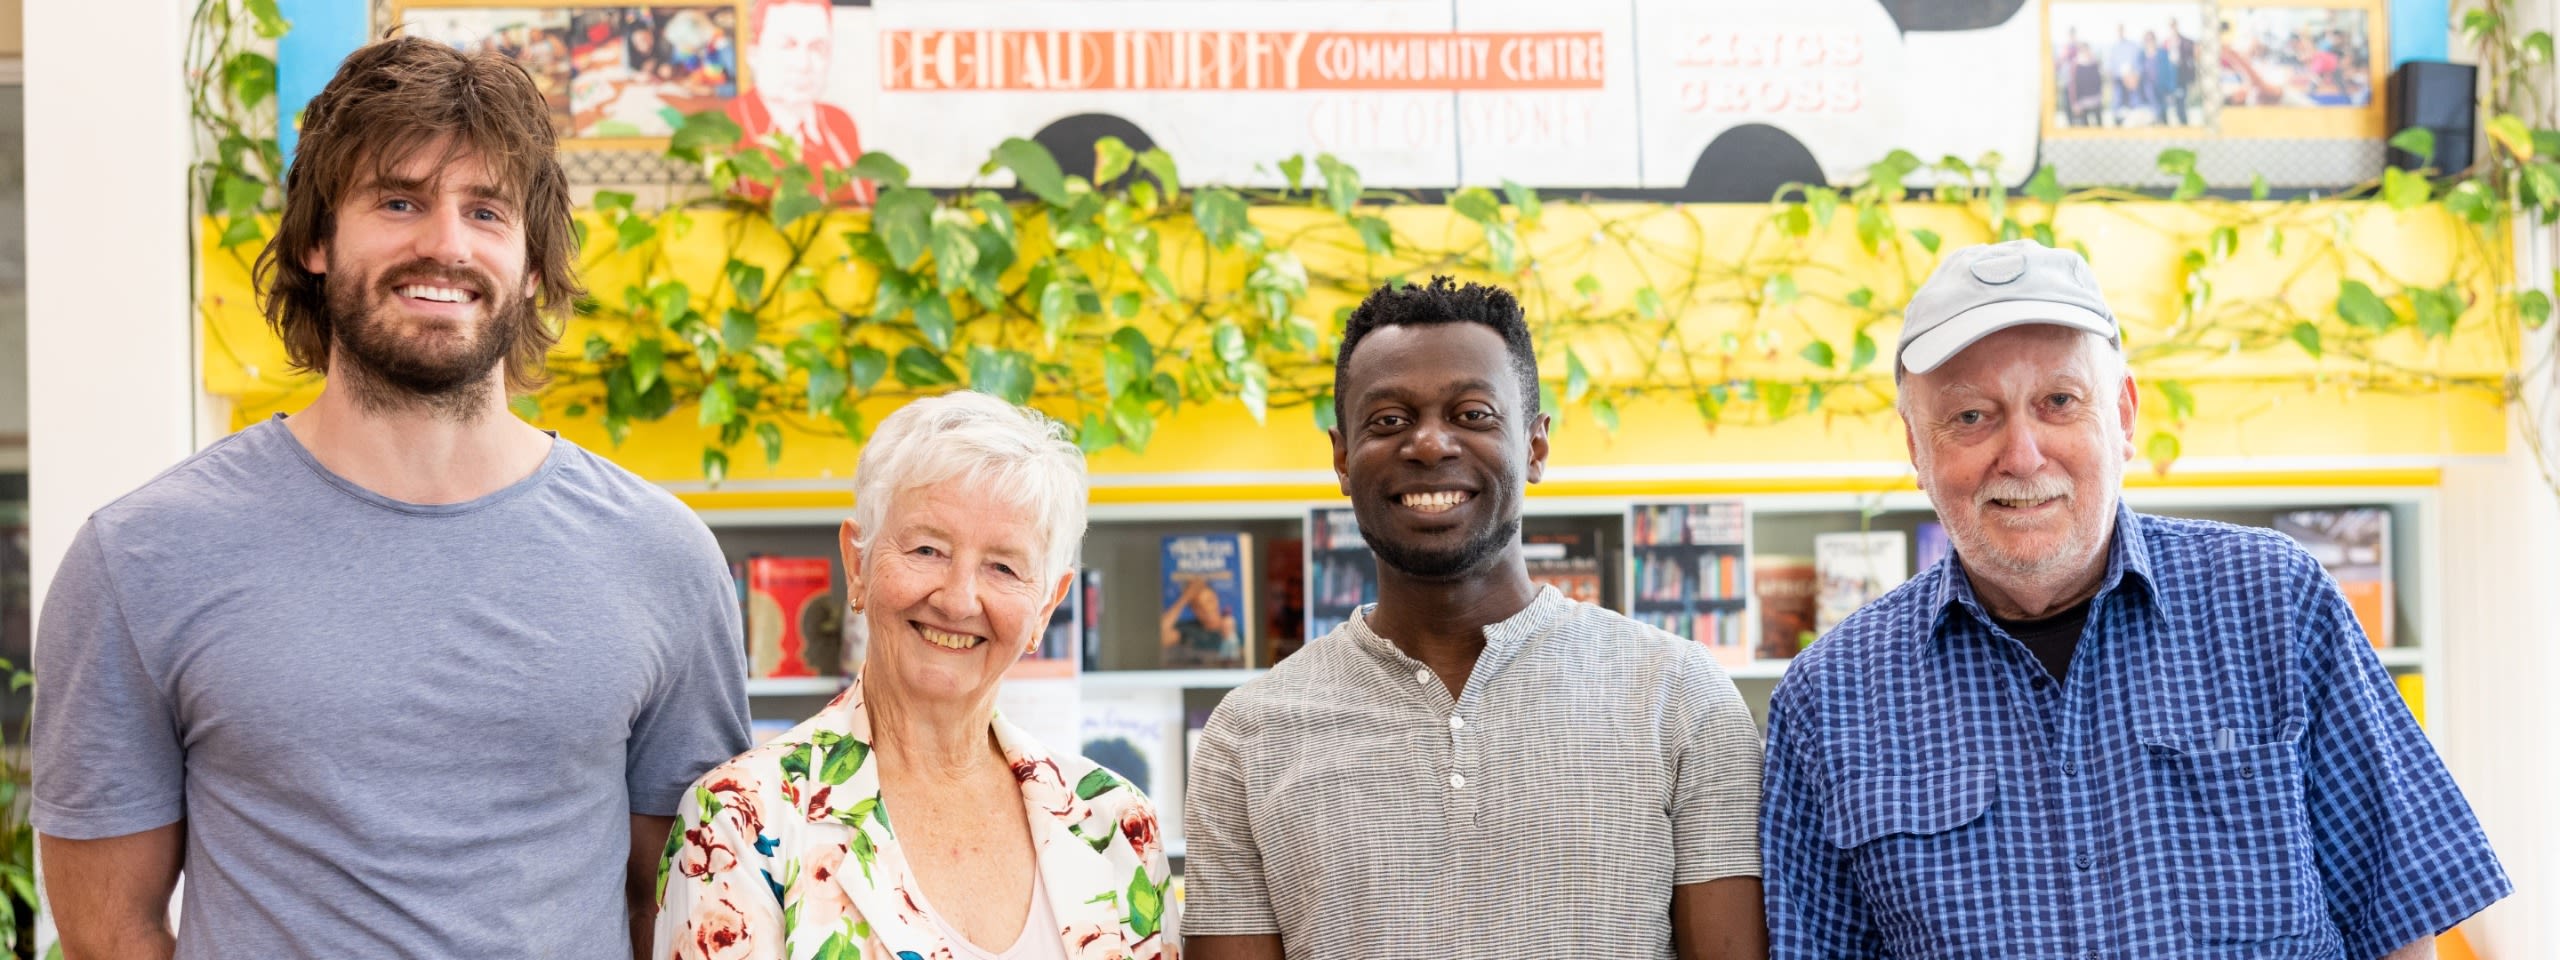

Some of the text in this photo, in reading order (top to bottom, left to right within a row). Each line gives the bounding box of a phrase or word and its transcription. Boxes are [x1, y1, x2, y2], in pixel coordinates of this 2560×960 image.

[883, 31, 1602, 88] REGINALD MURPHY COMMUNITY CENTRE
[1306, 95, 1597, 149] CITY OF SYDNEY
